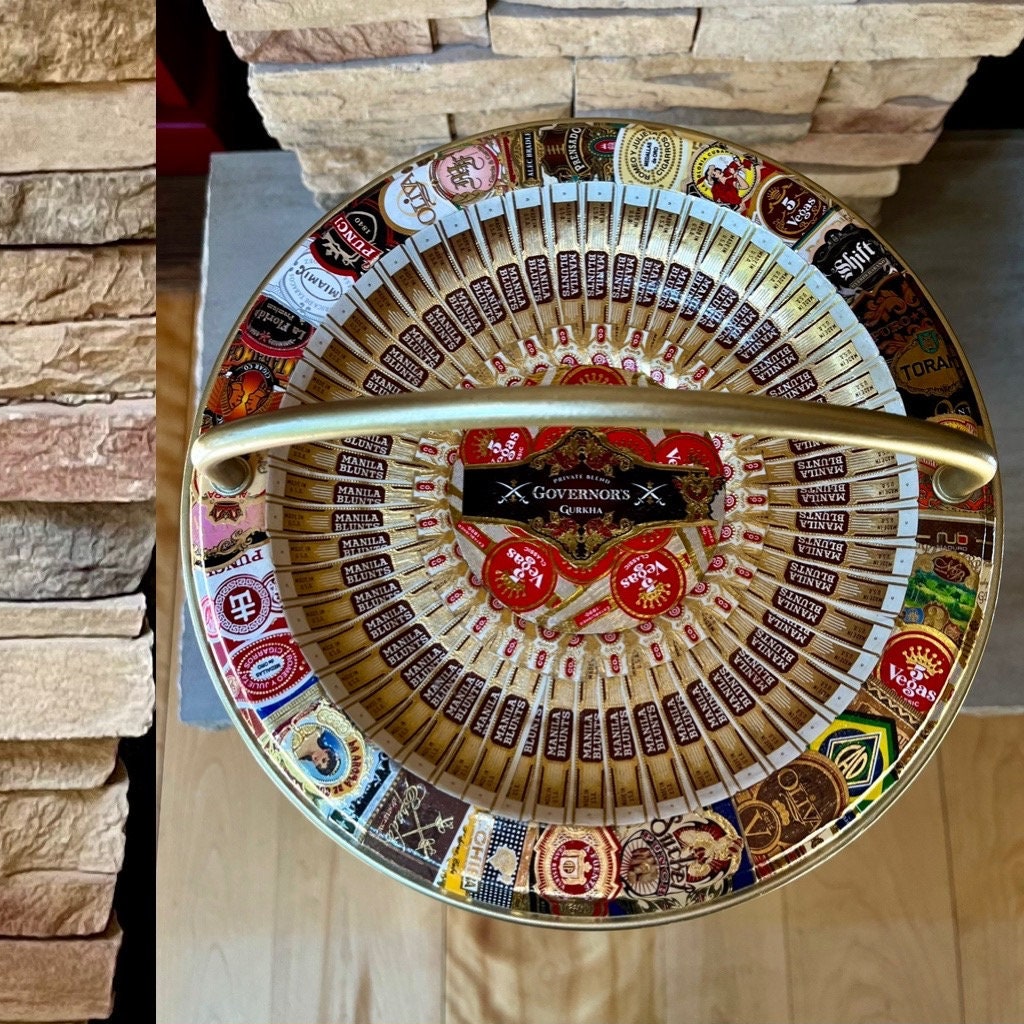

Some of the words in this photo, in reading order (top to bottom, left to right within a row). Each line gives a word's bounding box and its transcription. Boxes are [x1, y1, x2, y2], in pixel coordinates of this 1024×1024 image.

[568, 127, 586, 172] PRENSADO
[656, 136, 672, 176] CIGARROS
[630, 157, 651, 180] ROMEO
[400, 172, 436, 226] OLIVA
[781, 196, 796, 211] 5
[786, 198, 816, 226] Vegas
[560, 254, 570, 297] BLUNTS
[569, 254, 579, 295] MANILA
[587, 255, 595, 297] BLUNTS
[596, 255, 604, 295] MANILA
[612, 256, 625, 298] BLUNTS
[834, 240, 876, 281] Shift
[304, 271, 340, 298] MIAMI
[499, 268, 519, 311] BLUNTS
[509, 266, 527, 308] MANILA
[621, 258, 635, 298] MANILA
[456, 290, 482, 331] MANILA
[472, 283, 495, 325] BLUNTS
[480, 278, 504, 320] MANILA
[431, 307, 463, 345] MANILA
[448, 295, 476, 338] BLUNTS
[726, 311, 756, 347] MANILA
[425, 314, 458, 353] BLUNTS
[382, 354, 421, 390] BLUNTS
[388, 347, 425, 381] MANILA
[752, 346, 789, 375] BLUNTS
[758, 355, 795, 382] MANILA
[342, 455, 384, 470] MANILA
[487, 440, 502, 454] 5
[799, 456, 843, 469] BLUNTS
[340, 464, 384, 479] BLUNTS
[801, 466, 843, 478] MANILA
[532, 485, 631, 501] GOVERNOR'S
[559, 504, 604, 516] GURKHA
[800, 511, 844, 521] BLUNTS
[801, 520, 842, 532] MANILA
[936, 531, 969, 545] nub
[344, 558, 389, 576] MANILA
[506, 547, 544, 589] Vegas
[523, 546, 547, 568] CLASSIC
[623, 553, 650, 570] CLASSIC
[792, 562, 835, 581] BLUNTS
[346, 567, 391, 584] BLUNTS
[509, 567, 526, 584] 5
[620, 560, 669, 588] Vegas
[640, 577, 656, 593] 5
[790, 573, 831, 593] MANILA
[779, 596, 817, 622] MANILA
[781, 587, 822, 613] BLUNTS
[365, 604, 408, 630] MANILA
[369, 612, 413, 639] BLUNTS
[243, 646, 284, 669] CIGARROS
[382, 628, 424, 657] MANILA
[387, 636, 430, 665] BLUNTS
[752, 636, 787, 668] MANILA
[756, 629, 795, 662] BLUNTS
[276, 654, 294, 682] ROMEO
[734, 655, 767, 691] MANILA
[740, 649, 775, 684] BLUNTS
[889, 663, 936, 702] Vegas
[910, 664, 926, 681] 5
[445, 675, 476, 716] MANILA
[454, 679, 485, 723] BLUNTS
[714, 673, 742, 712] MANILA
[720, 667, 750, 707] BLUNTS
[494, 699, 517, 741] MANILA
[503, 700, 526, 745] BLUNTS
[548, 712, 561, 755] MANILA
[558, 711, 570, 757] BLUNTS
[638, 709, 655, 752] MANILA
[648, 705, 665, 750] BLUNTS
[777, 768, 823, 831] OLIVA
